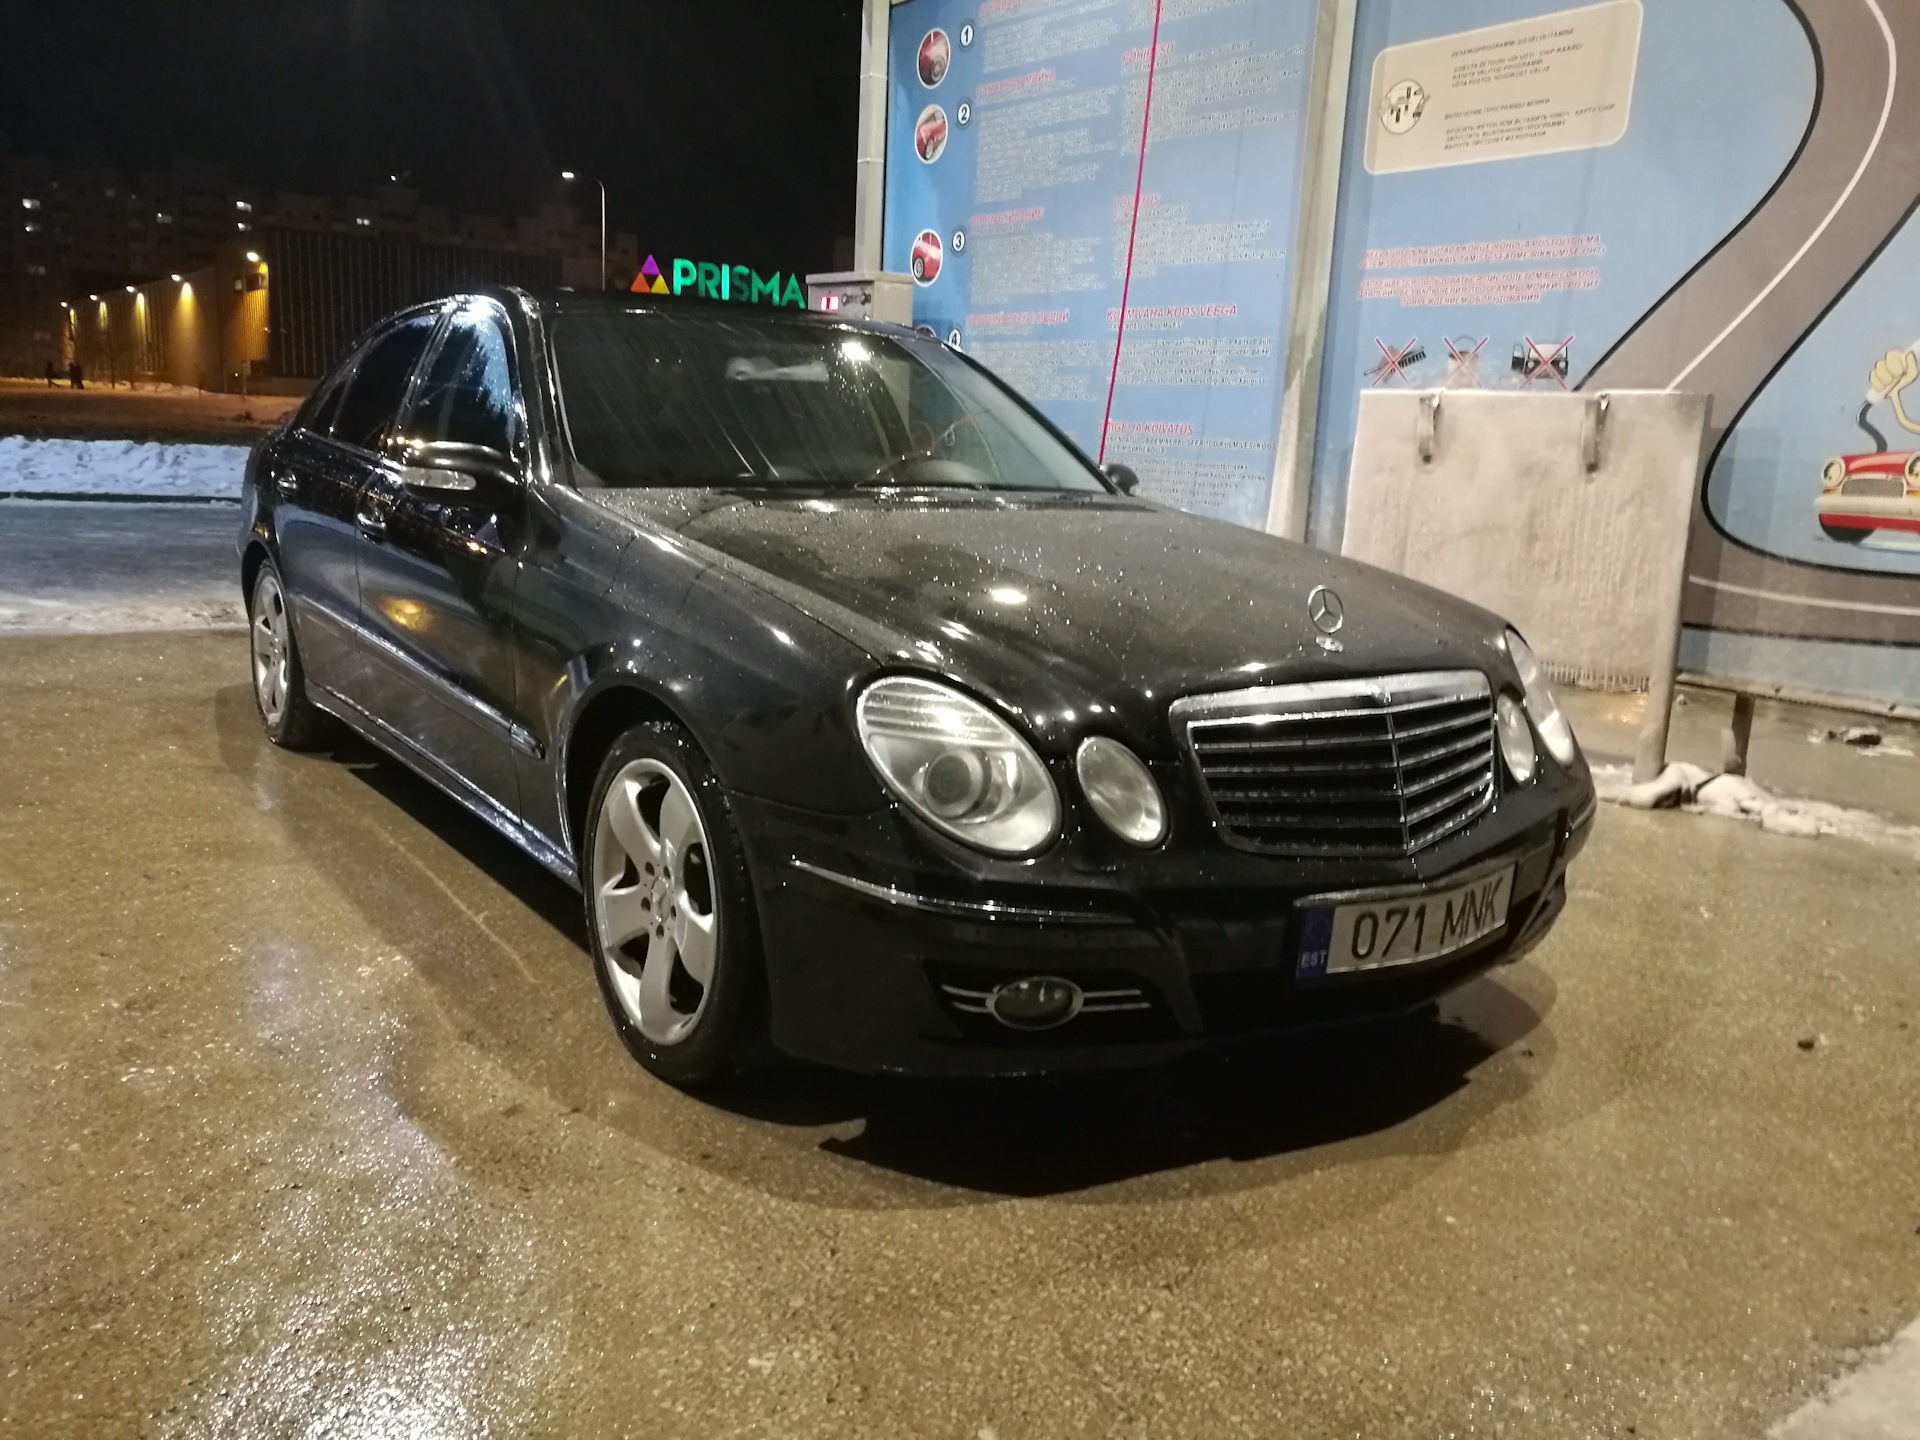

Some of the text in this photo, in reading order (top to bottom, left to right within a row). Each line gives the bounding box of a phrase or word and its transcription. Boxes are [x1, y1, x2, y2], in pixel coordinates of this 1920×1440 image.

[963, 27, 970, 43] 1
[960, 106, 969, 121] 2
[955, 235, 964, 249] 3
[672, 258, 806, 310] PRISMA
[1166, 305, 1197, 318] KOOS
[1200, 304, 1237, 317] VEEGA
[1144, 423, 1193, 436] KUIVATUS
[1351, 876, 1503, 960] 071 MNK
[1301, 951, 1327, 968] EST
